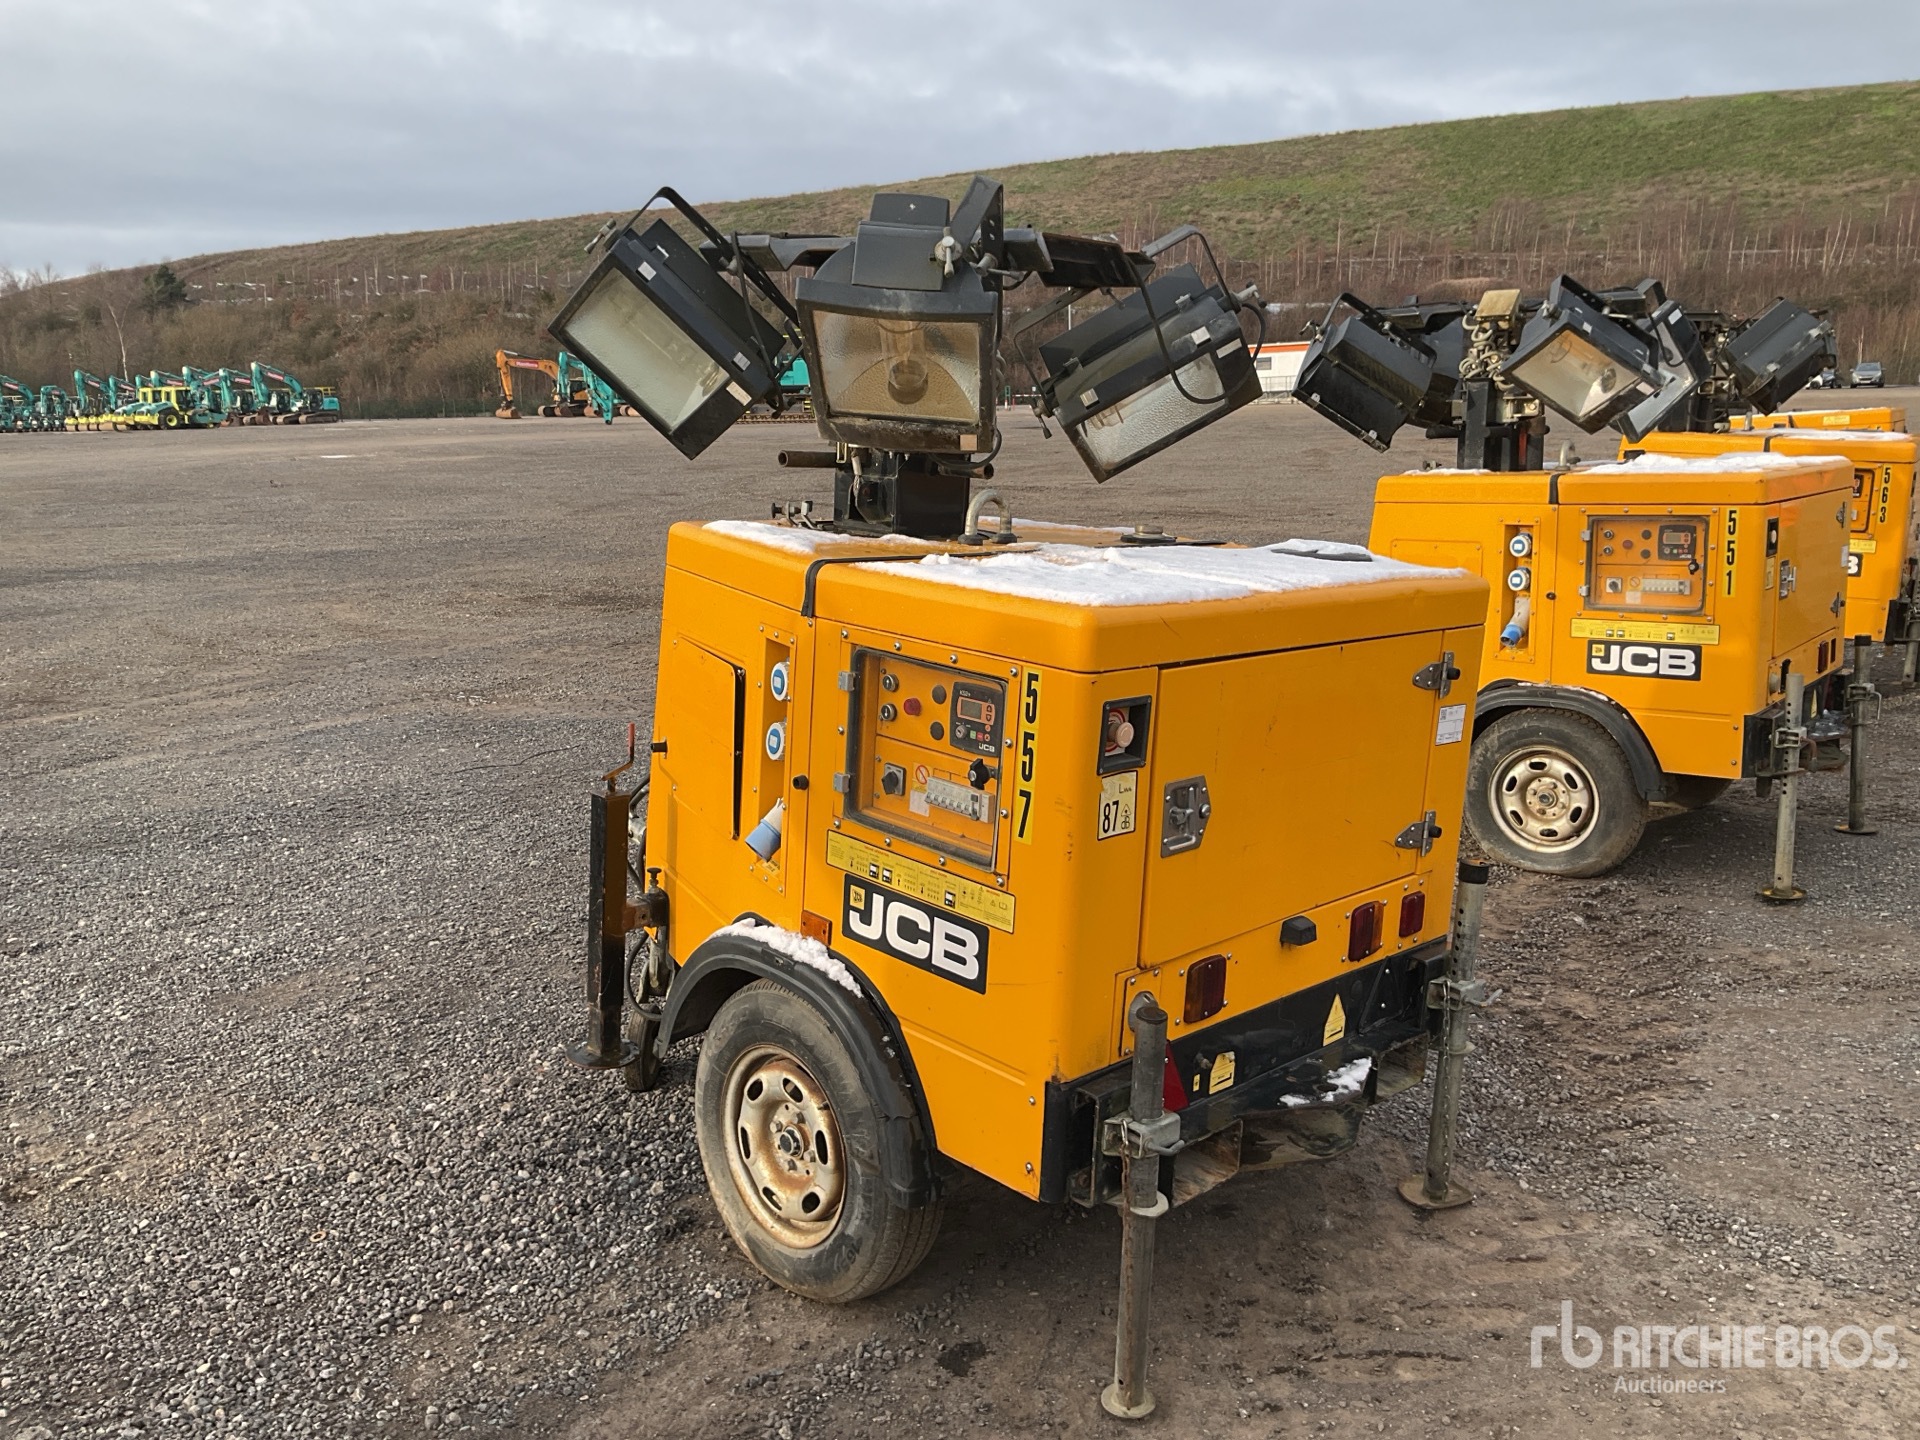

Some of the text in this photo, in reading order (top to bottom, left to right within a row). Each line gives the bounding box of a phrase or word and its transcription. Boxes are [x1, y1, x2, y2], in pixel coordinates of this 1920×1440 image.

[1879, 467, 1891, 523] 563
[1725, 510, 1737, 596] 551
[1591, 645, 1696, 676] JCB
[1017, 671, 1039, 839] 557
[1102, 799, 1119, 834] 87
[848, 893, 980, 980] JCB
